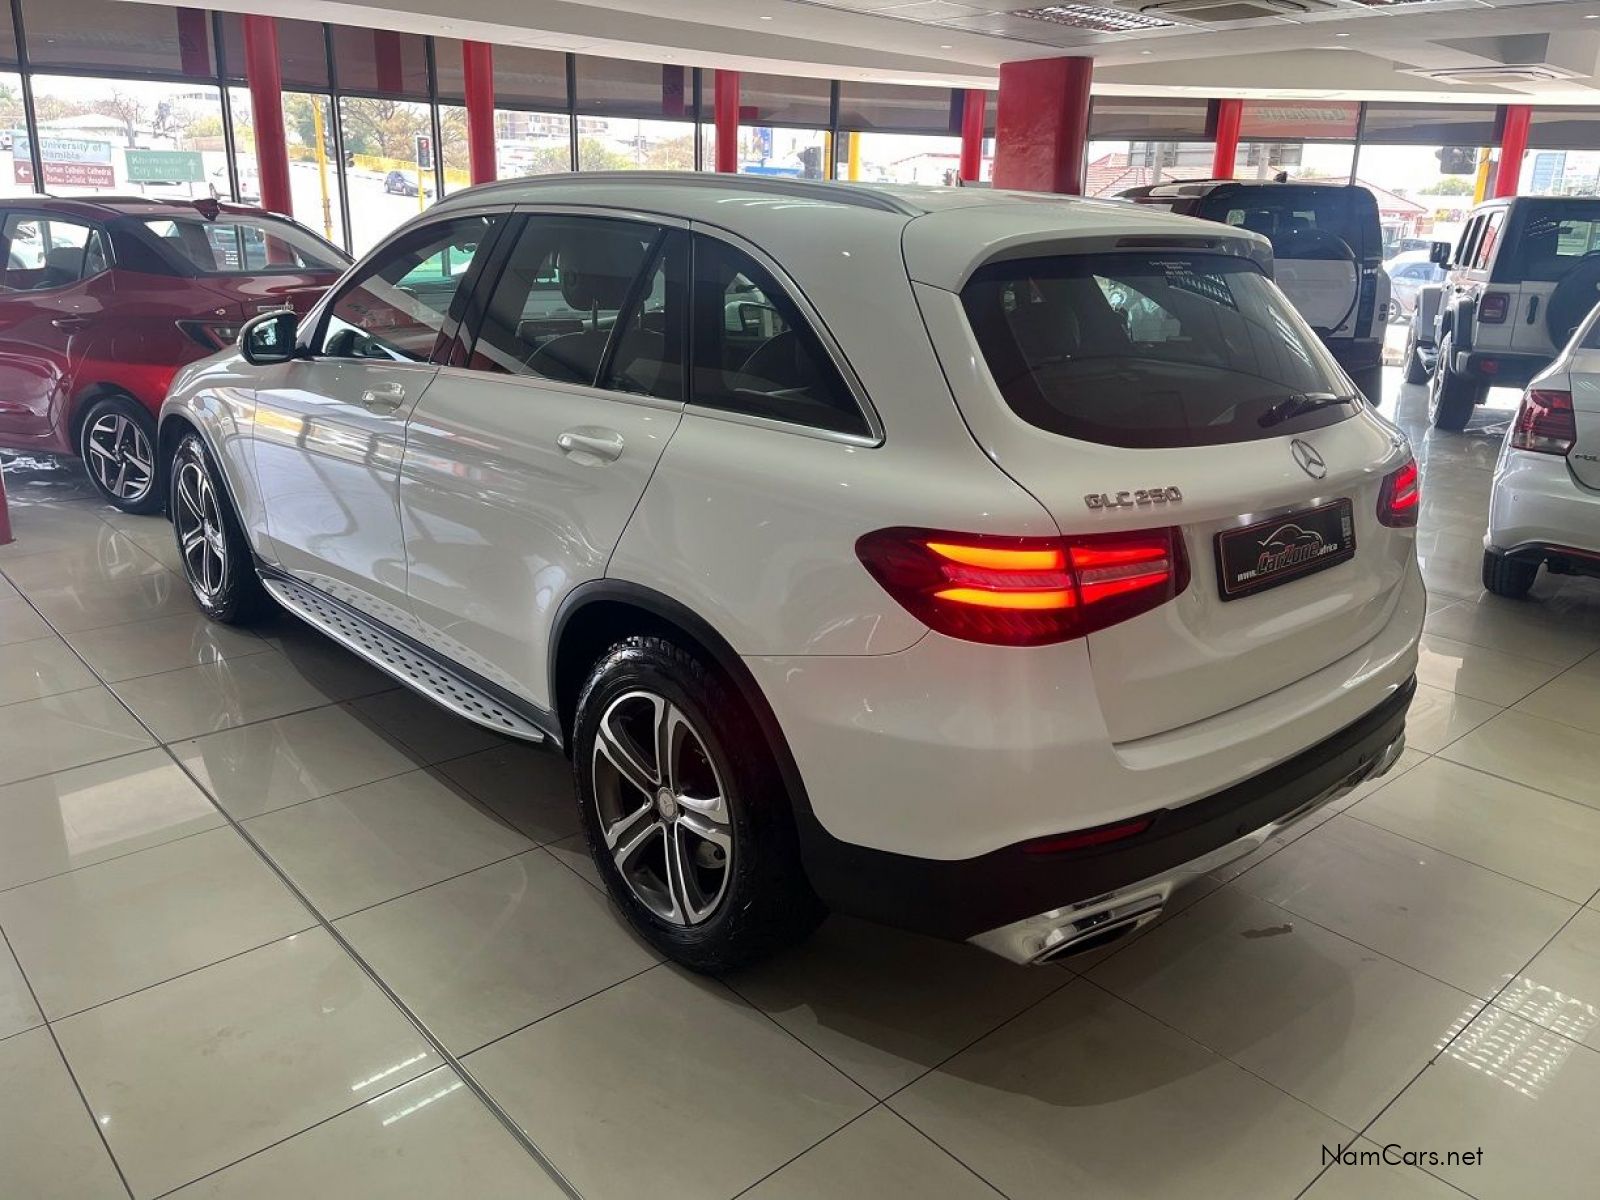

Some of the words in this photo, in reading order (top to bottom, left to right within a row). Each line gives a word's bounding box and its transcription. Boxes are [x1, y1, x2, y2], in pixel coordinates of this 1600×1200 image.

[42, 141, 88, 152] University
[93, 144, 103, 152] of
[1084, 491, 1134, 508] GLC
[1135, 486, 1182, 505] 250
